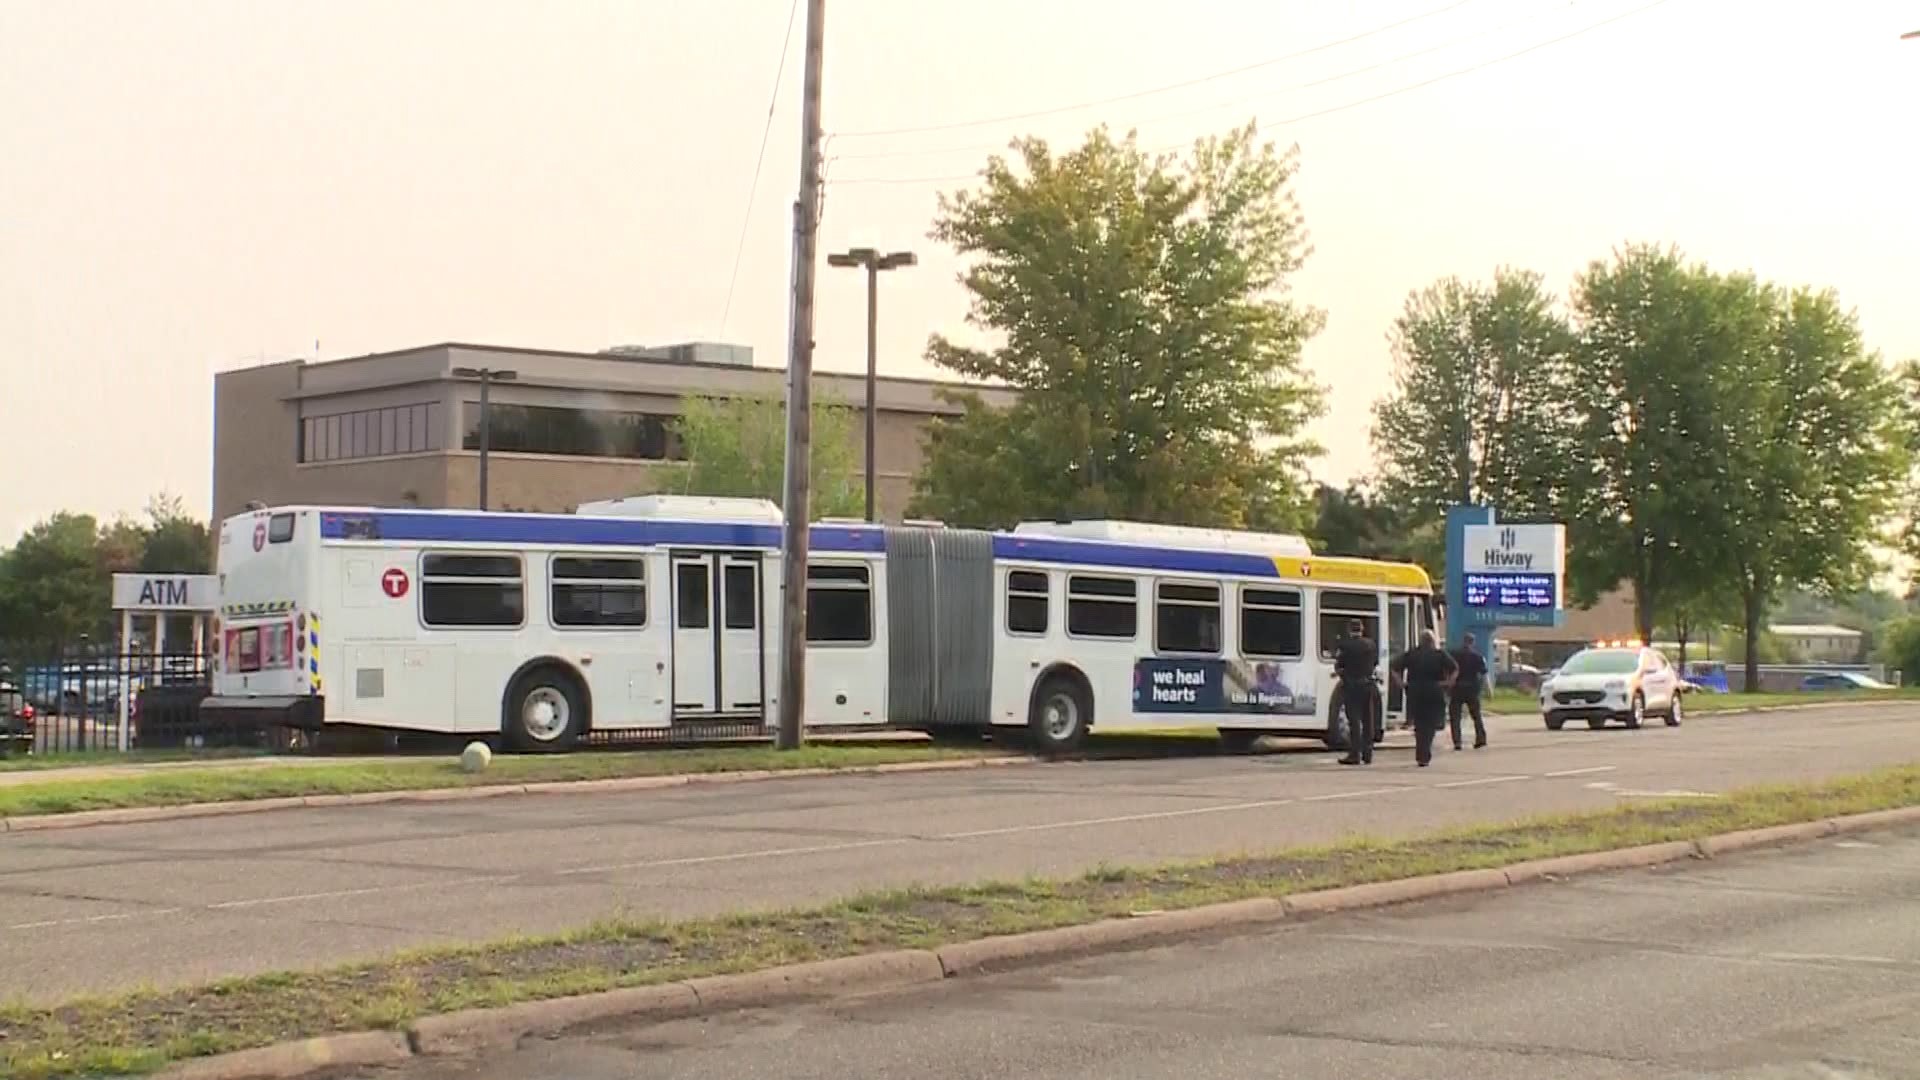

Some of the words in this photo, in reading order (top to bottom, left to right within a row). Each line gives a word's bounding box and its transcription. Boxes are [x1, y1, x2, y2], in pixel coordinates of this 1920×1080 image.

[1484, 549, 1533, 570] Hiway
[138, 579, 188, 605] ATM
[1153, 672, 1172, 685] we
[1175, 669, 1205, 685] heal
[1153, 686, 1196, 702] hearts
